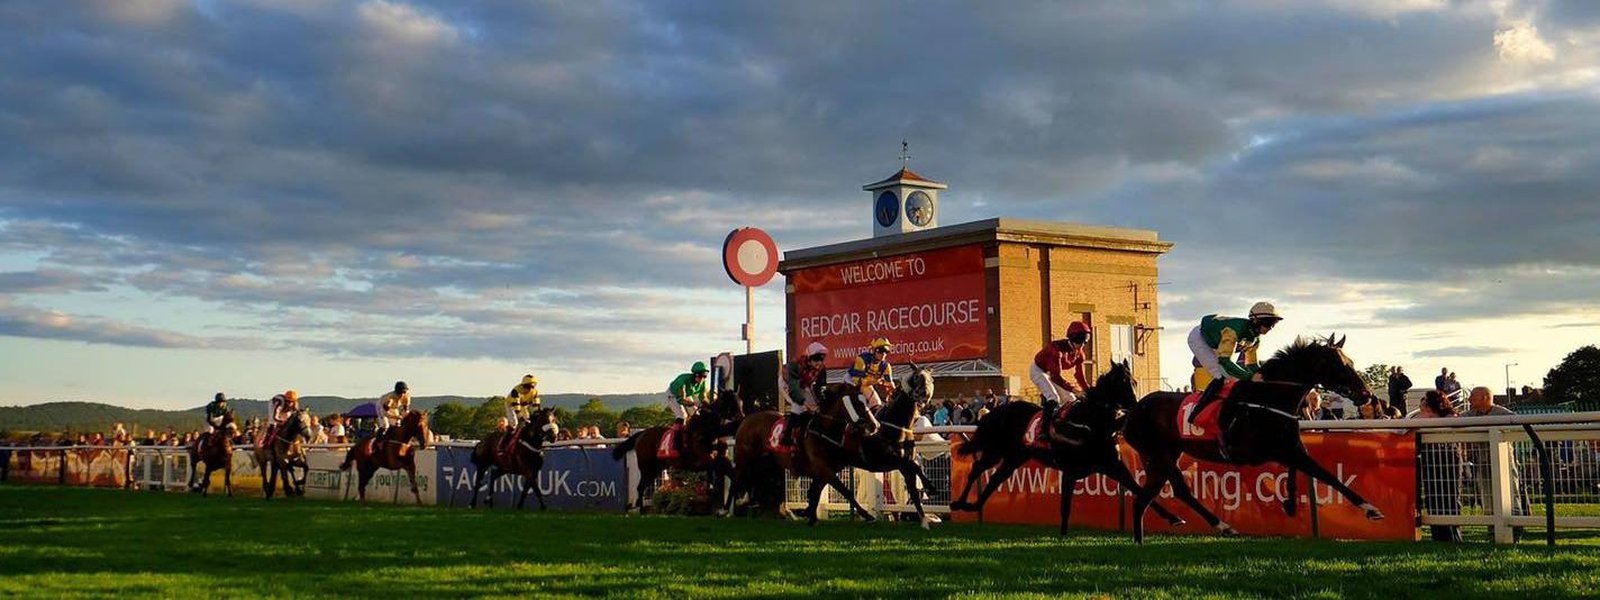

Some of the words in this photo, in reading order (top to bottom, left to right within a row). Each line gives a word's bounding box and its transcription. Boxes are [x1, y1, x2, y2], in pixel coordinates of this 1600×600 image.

[841, 260, 904, 285] WELCOME
[906, 257, 926, 276] TO
[801, 312, 861, 338] REDCAR
[867, 299, 980, 332] RACECOURSE
